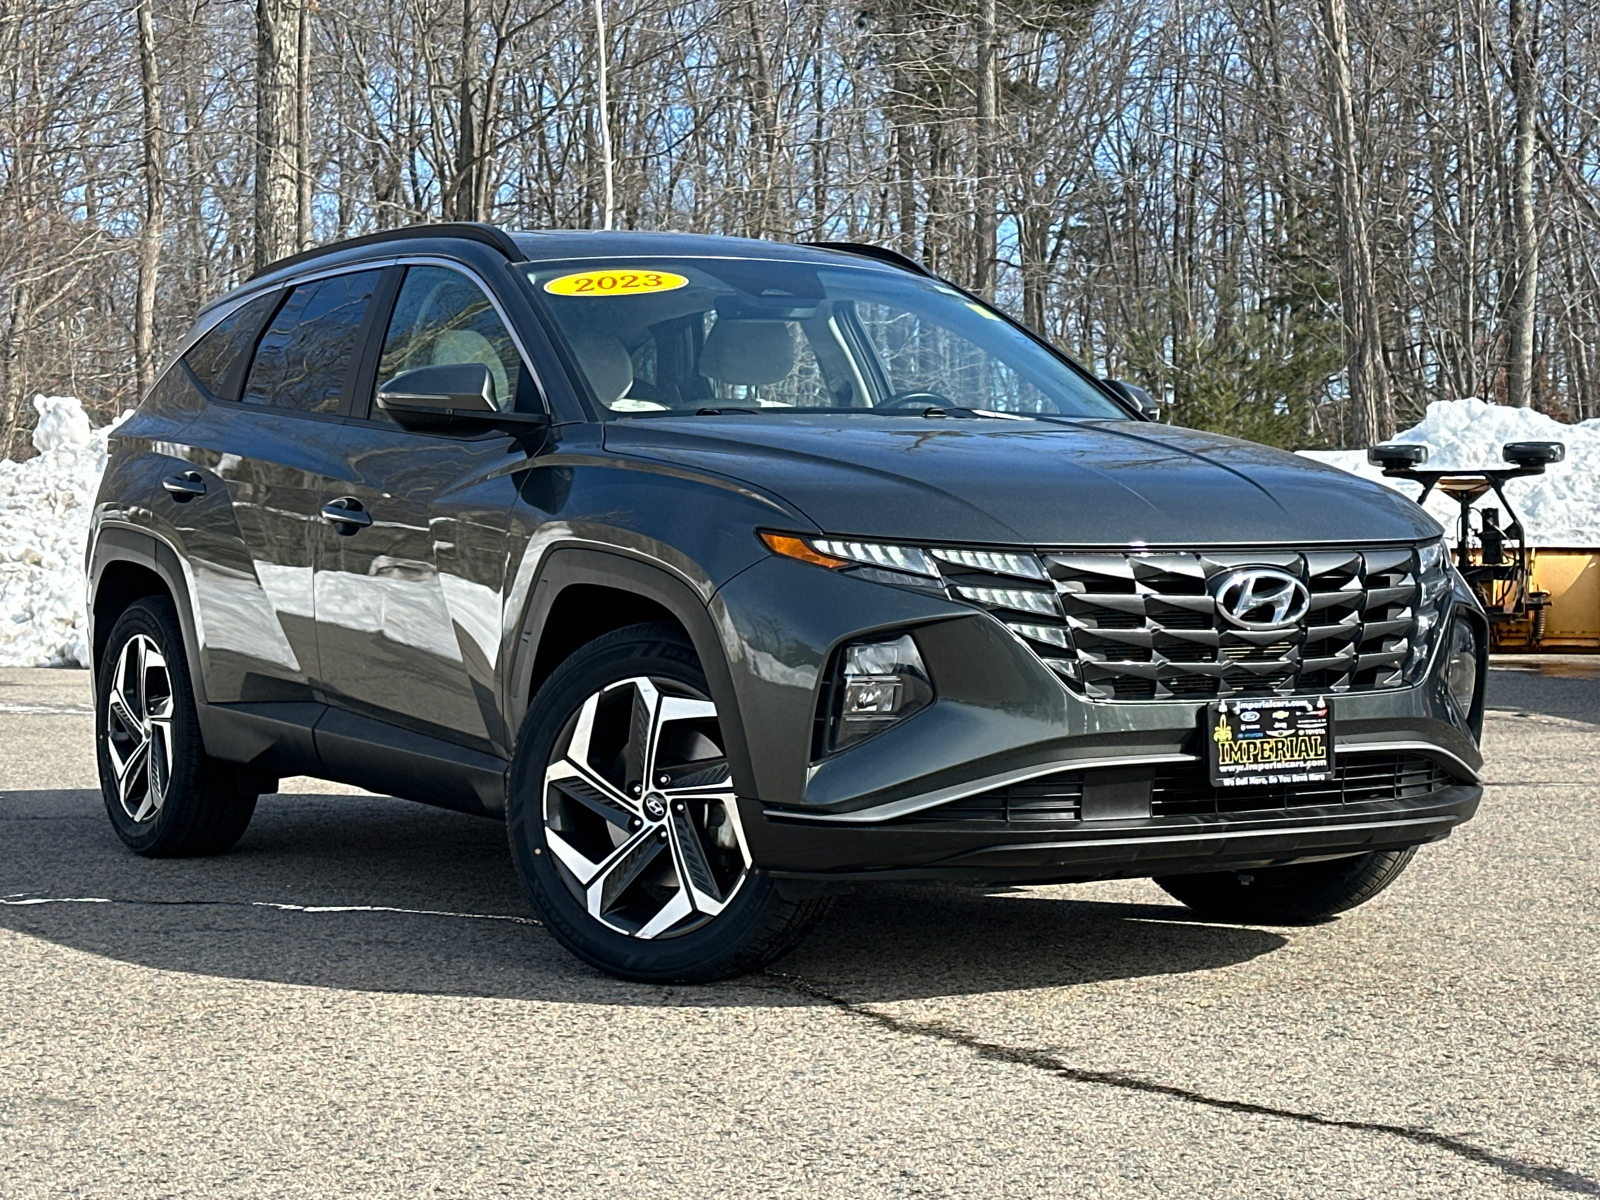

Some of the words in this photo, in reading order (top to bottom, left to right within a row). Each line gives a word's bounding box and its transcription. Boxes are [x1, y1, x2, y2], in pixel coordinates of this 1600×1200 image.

[574, 274, 663, 292] 2023
[1219, 736, 1326, 764] IMPERIAL
[1236, 777, 1248, 785] Sell
[1278, 775, 1291, 783] You
